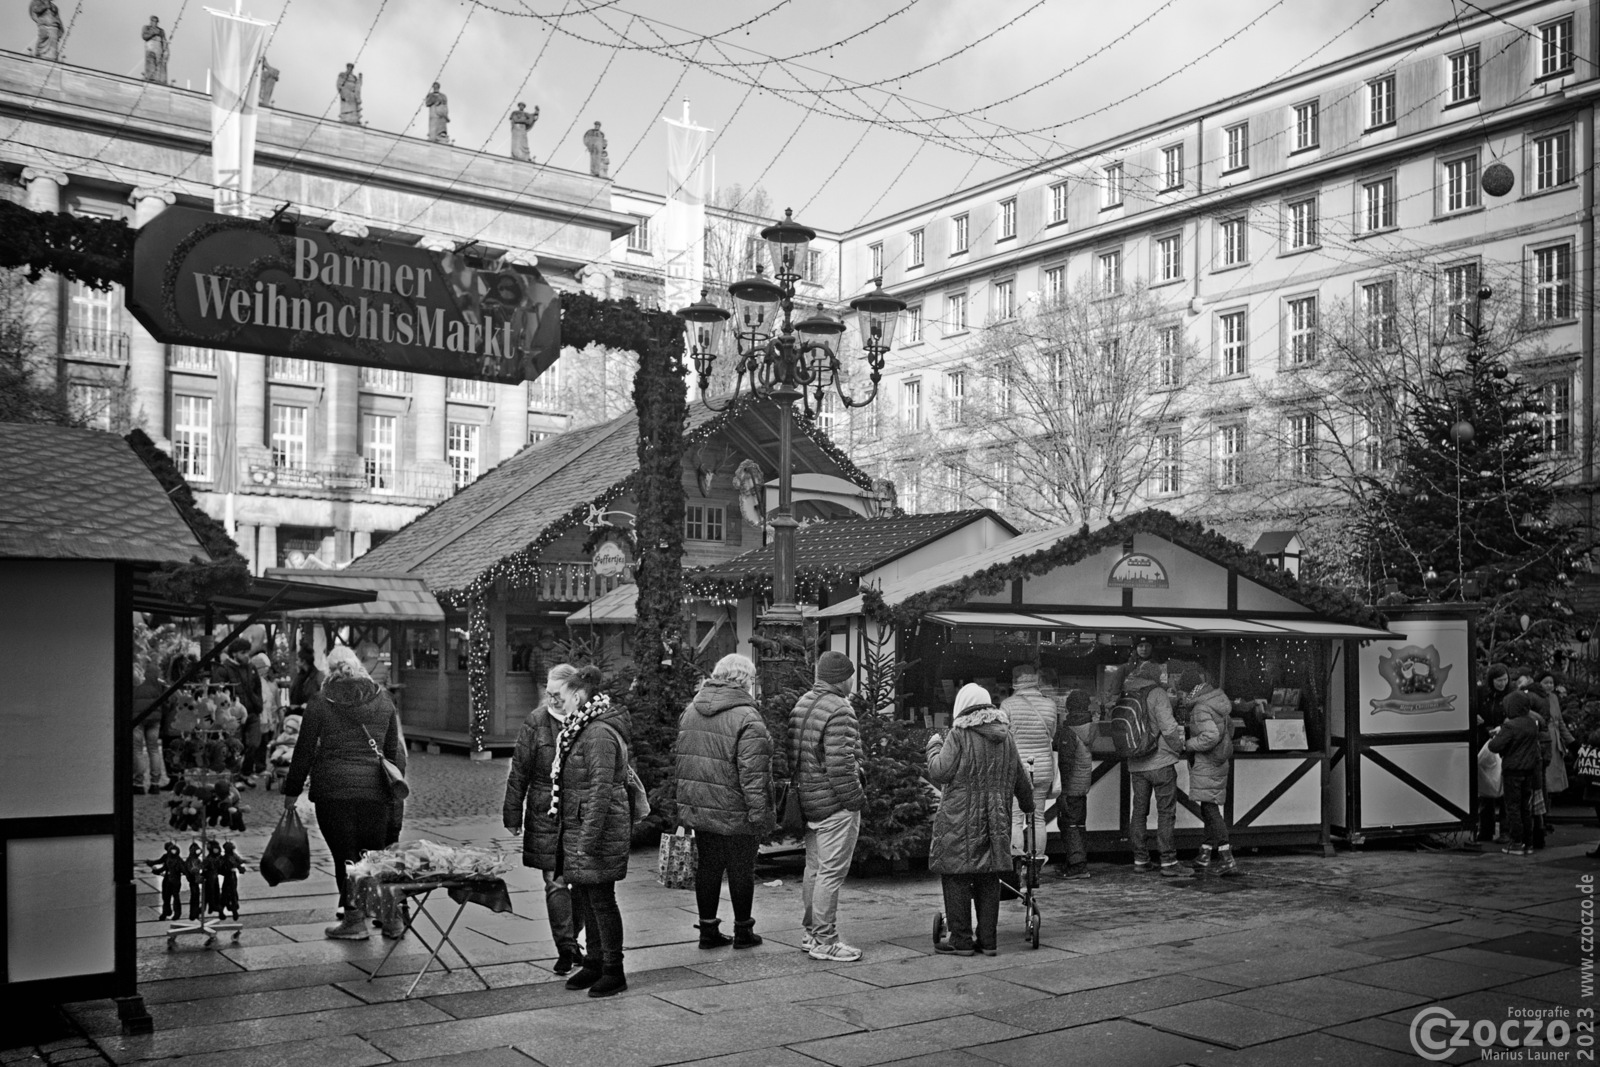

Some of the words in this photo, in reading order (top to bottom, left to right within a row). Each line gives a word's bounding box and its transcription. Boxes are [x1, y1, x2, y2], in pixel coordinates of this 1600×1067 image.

[294, 235, 433, 300] Barmer
[193, 271, 516, 360] WeihnachtsMarkt
[593, 553, 625, 567] Poffertjes
